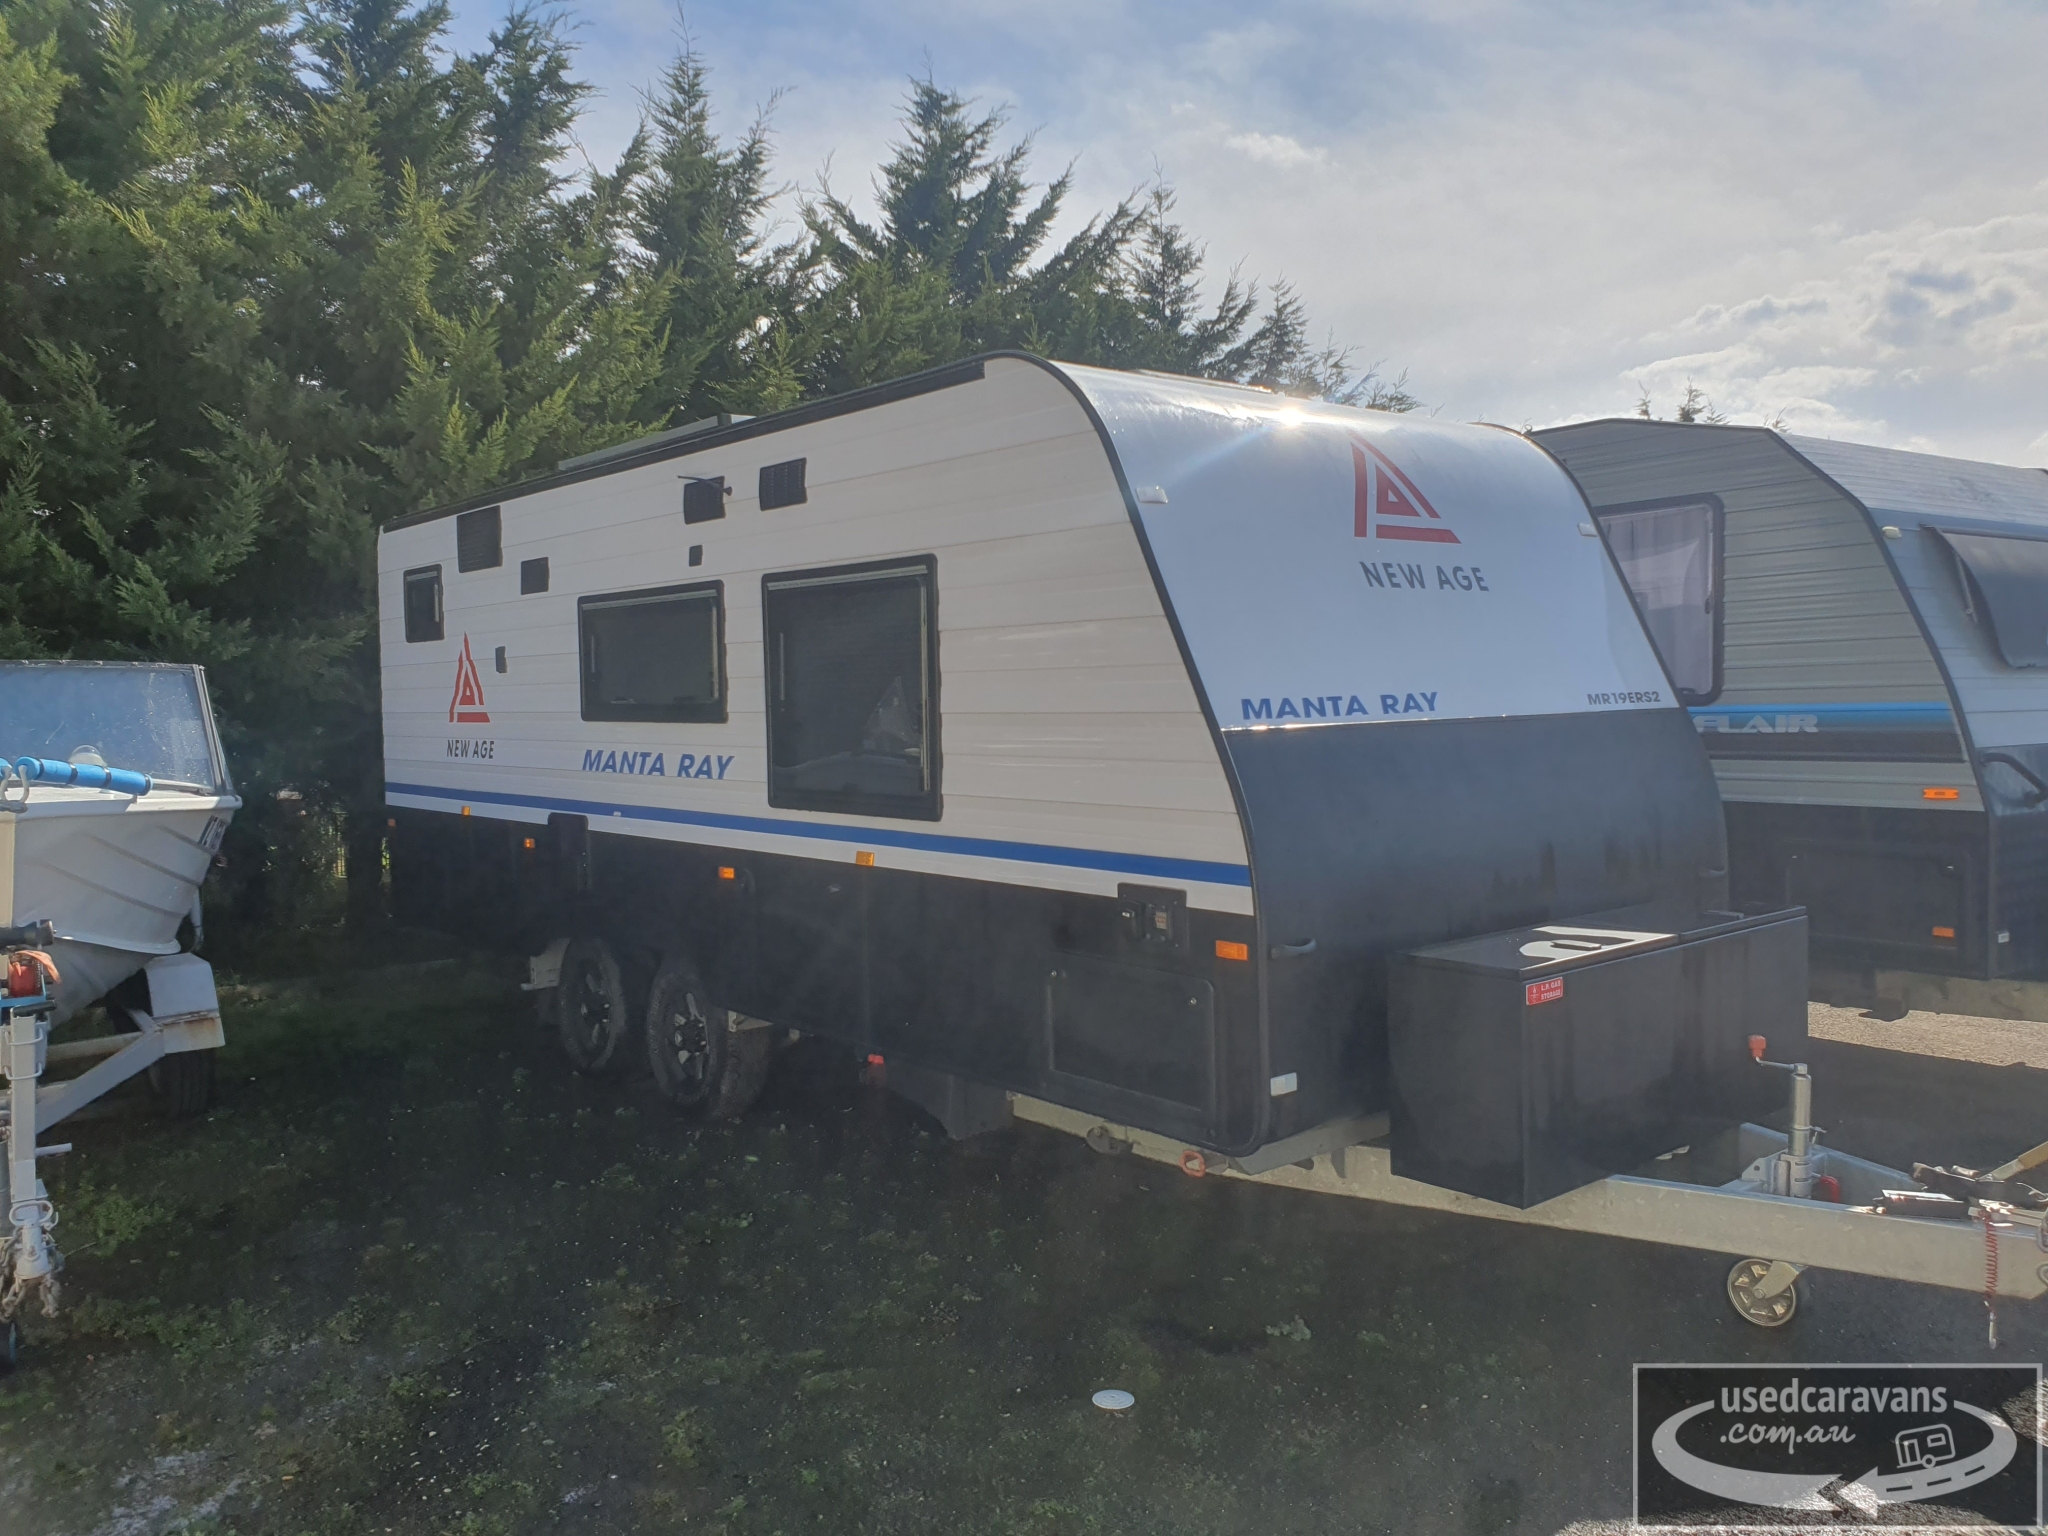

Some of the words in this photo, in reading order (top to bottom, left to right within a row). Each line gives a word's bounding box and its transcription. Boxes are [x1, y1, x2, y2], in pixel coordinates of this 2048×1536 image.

[1359, 561, 1426, 589] NEW
[1436, 565, 1489, 592] AGE
[1241, 695, 1369, 720] MANTA
[1380, 692, 1438, 714] RAY
[1587, 691, 1661, 705] MR19ERS2
[1692, 714, 1819, 733] FLAIR
[447, 739, 470, 758] NEW
[472, 741, 495, 759] AGE
[582, 749, 666, 776] MANTA
[677, 754, 735, 780] RAY
[1551, 980, 1561, 989] GAS
